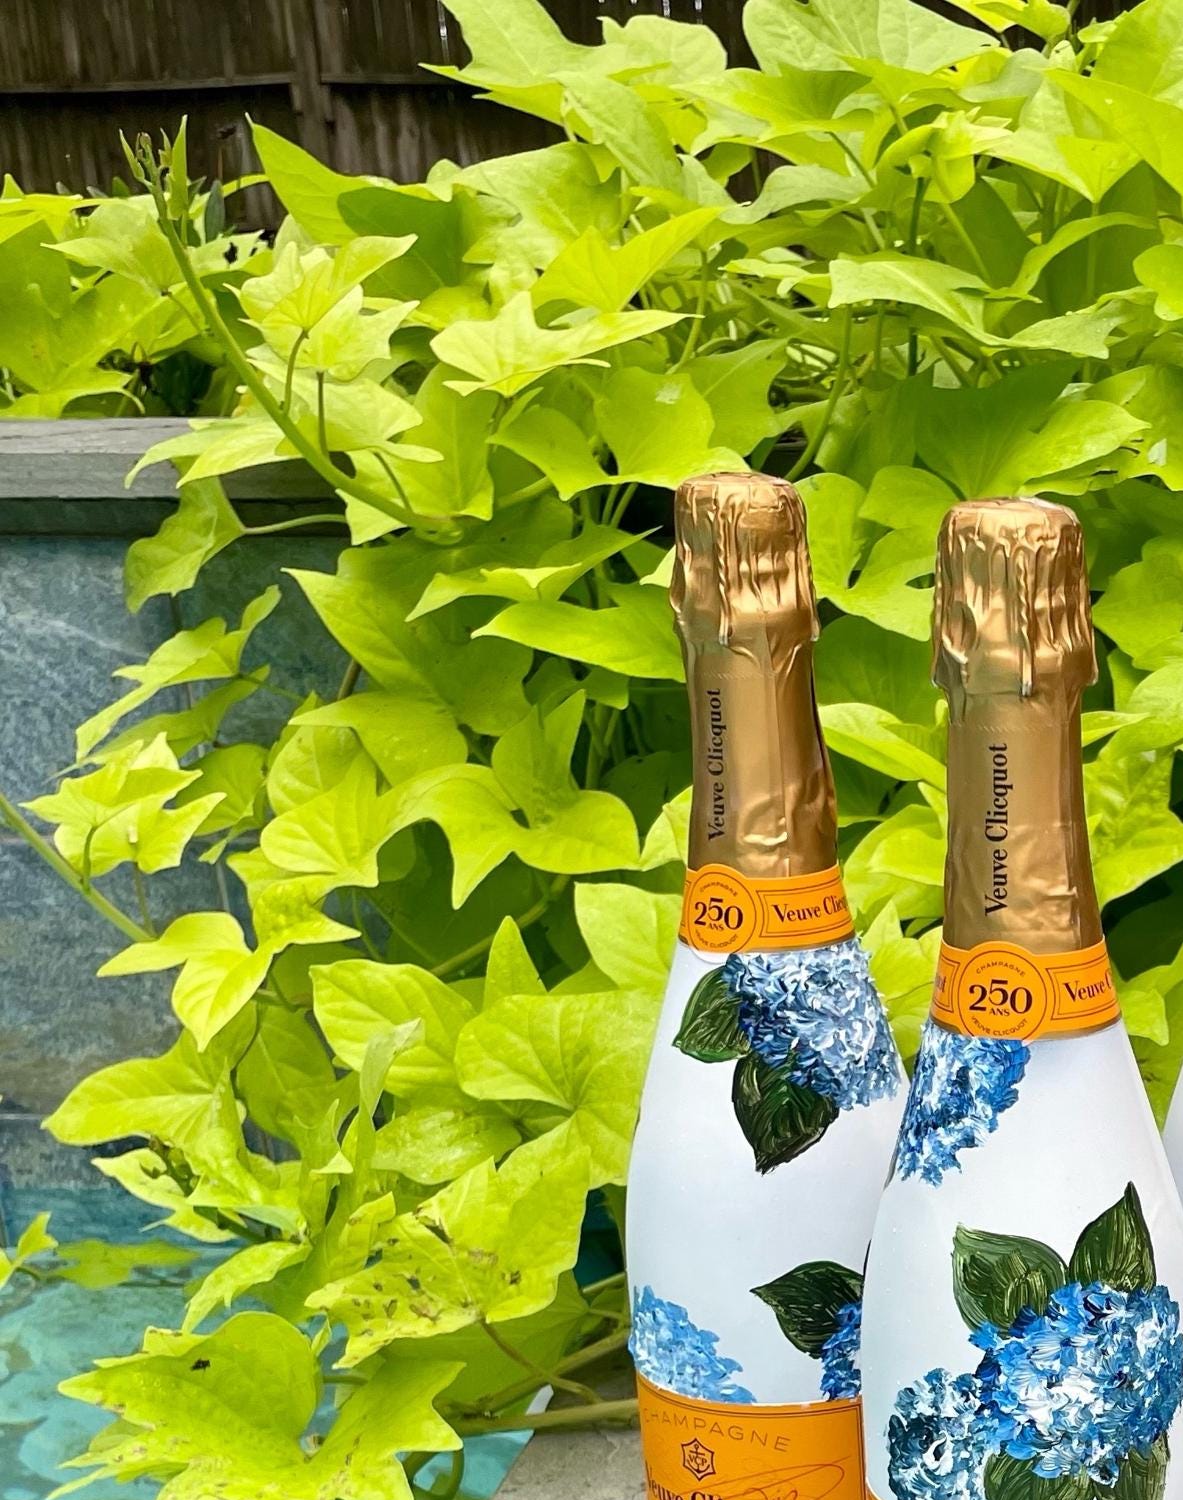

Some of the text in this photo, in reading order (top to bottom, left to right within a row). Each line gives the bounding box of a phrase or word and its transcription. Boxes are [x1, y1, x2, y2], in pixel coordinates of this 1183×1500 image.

[706, 688, 727, 841] Veuve Clicquot
[984, 743, 1013, 917] Veuve Clicquot
[693, 897, 744, 930] 250
[772, 902, 821, 923] Veuve
[707, 922, 725, 931] ANS
[976, 961, 1026, 977] CHAMPAGNE
[968, 979, 1033, 1014] 250
[1062, 980, 1105, 1002] Veuve
[989, 1007, 1010, 1017] ANS
[971, 1015, 1028, 1036] VEUVE CLICQUOT
[644, 1407, 791, 1452] CHAMPAGNE
